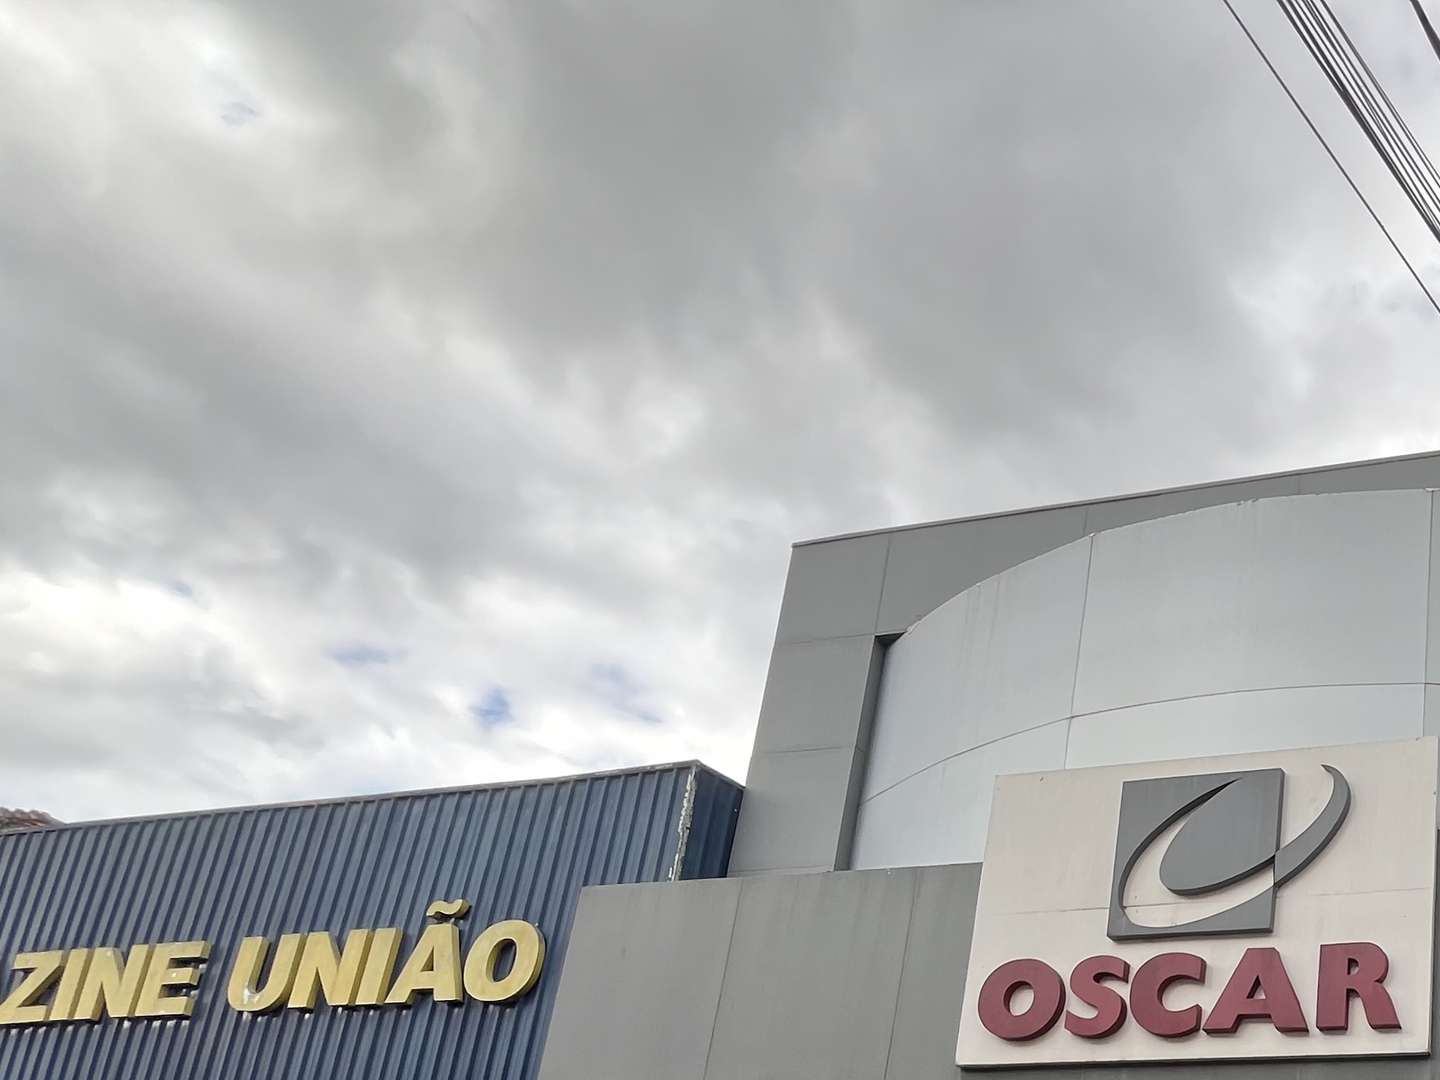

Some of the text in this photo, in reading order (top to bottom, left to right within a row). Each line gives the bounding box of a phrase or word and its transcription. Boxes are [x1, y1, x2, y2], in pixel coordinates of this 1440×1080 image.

[0, 898, 547, 1025] ZINE UNIÃO
[977, 941, 1402, 1042] OSCAR
